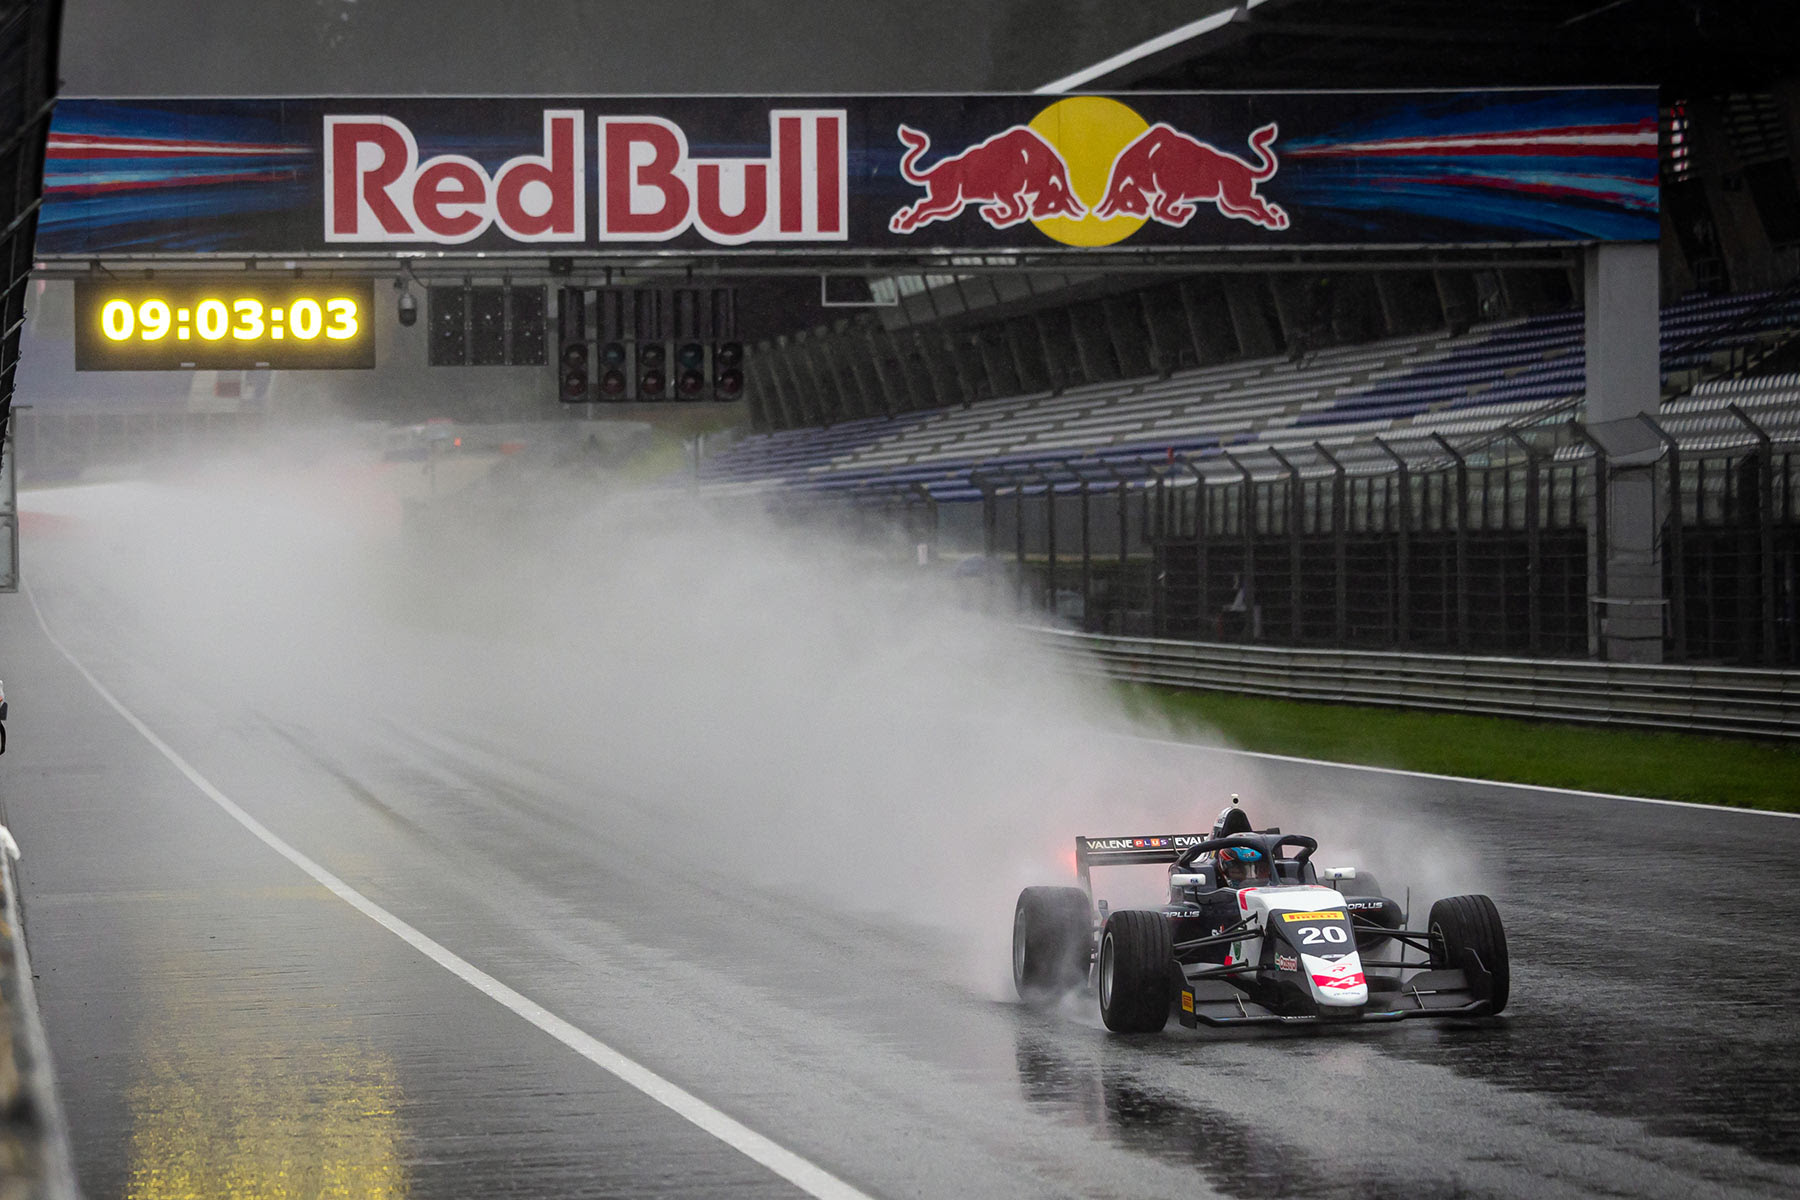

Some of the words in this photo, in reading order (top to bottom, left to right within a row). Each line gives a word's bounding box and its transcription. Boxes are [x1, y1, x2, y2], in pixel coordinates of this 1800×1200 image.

[324, 109, 586, 243] Red
[599, 109, 848, 245] Bull
[101, 298, 359, 341] 09:03:03
[1086, 840, 1133, 849] VALENE
[1134, 838, 1168, 847] PLUS
[1298, 926, 1347, 944] 20
